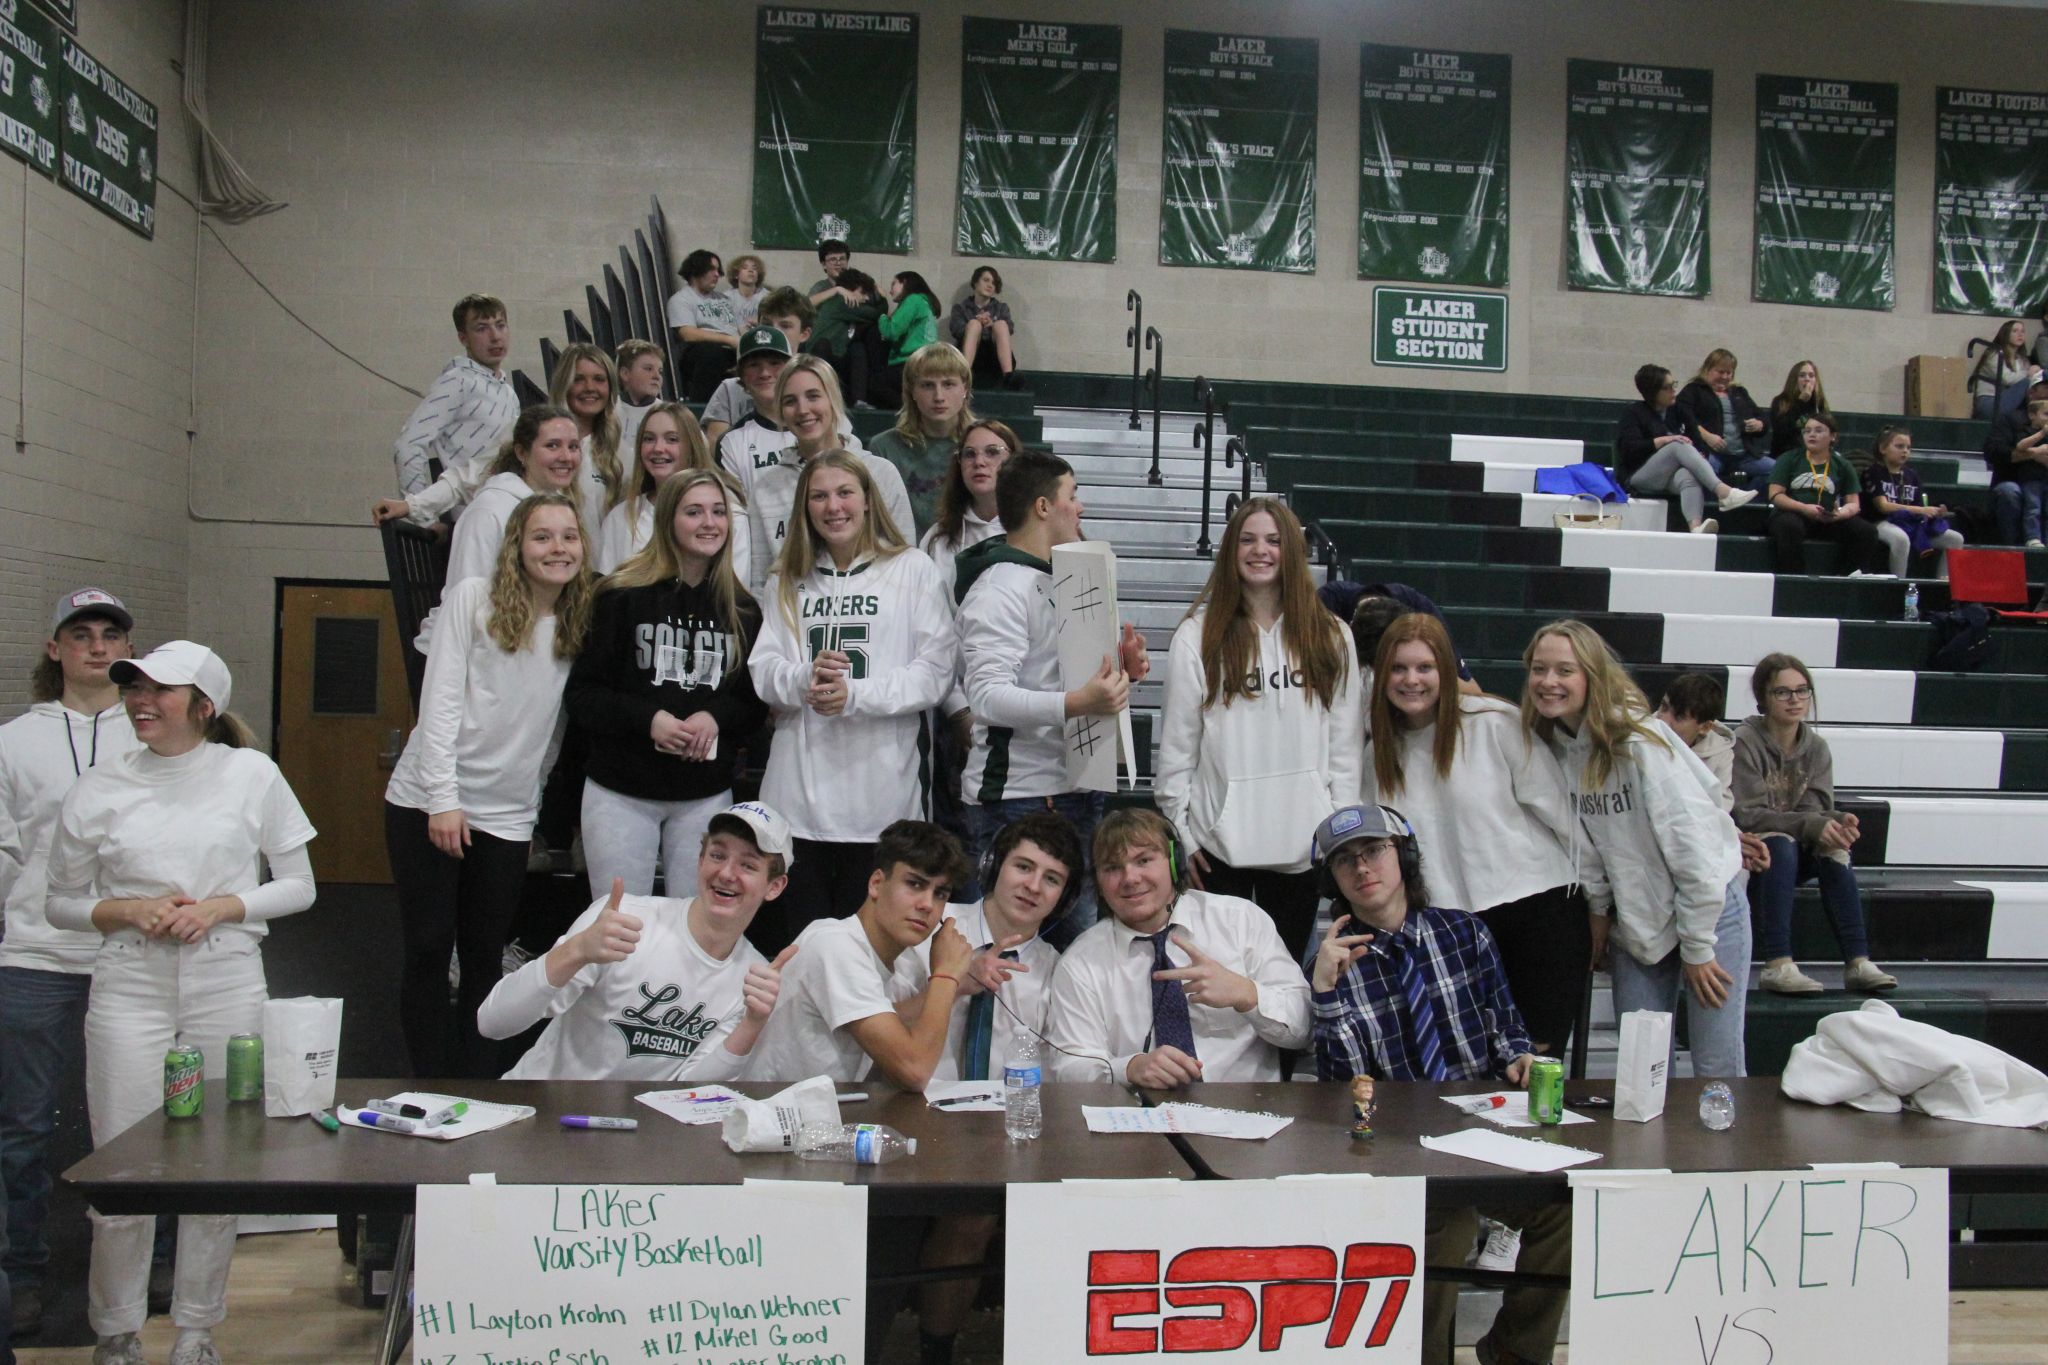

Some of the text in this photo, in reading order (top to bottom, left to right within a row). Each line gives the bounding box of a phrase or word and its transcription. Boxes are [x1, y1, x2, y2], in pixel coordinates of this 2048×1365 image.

[766, 10, 910, 32] LAKER WRESTLING
[1019, 24, 1067, 41] LAKER
[1007, 39, 1077, 55] MEN'S GOLF
[1218, 37, 1265, 54] LAKER
[1242, 54, 1273, 67] TRACK
[1413, 53, 1459, 69] LAKER
[62, 36, 156, 130] LAKER VOLLEYBALL
[1433, 69, 1474, 82] SOCCER
[1618, 66, 1663, 84] LAKER
[1629, 83, 1685, 98] BASEBALL
[1805, 81, 1850, 99] LAKER
[1949, 90, 2048, 111] LAKER FOOTBA
[1778, 94, 1877, 113] BOY'S BASKETBALL
[95, 115, 129, 167] 1995
[1242, 144, 1274, 157] TRACK
[63, 150, 101, 196] STATE
[1406, 298, 1475, 319] LAKER
[1392, 318, 1488, 340] STUDENT
[1396, 338, 1483, 360] SECTION
[753, 451, 783, 469] LA
[803, 594, 879, 618] LAKERS
[807, 623, 869, 680] 15
[632, 1031, 692, 1055] BASEBALL
[1594, 1180, 1917, 1299] LAKER
[534, 1235, 628, 1277] Varsity
[648, 1295, 851, 1326] #11 Dylan Wehner
[1086, 1243, 1416, 1356] ESPN
[416, 1301, 627, 1338] #1 Layton Krohn
[641, 1331, 687, 1358] #12
[769, 1324, 828, 1346] Good
[1694, 1307, 1776, 1365] VS
